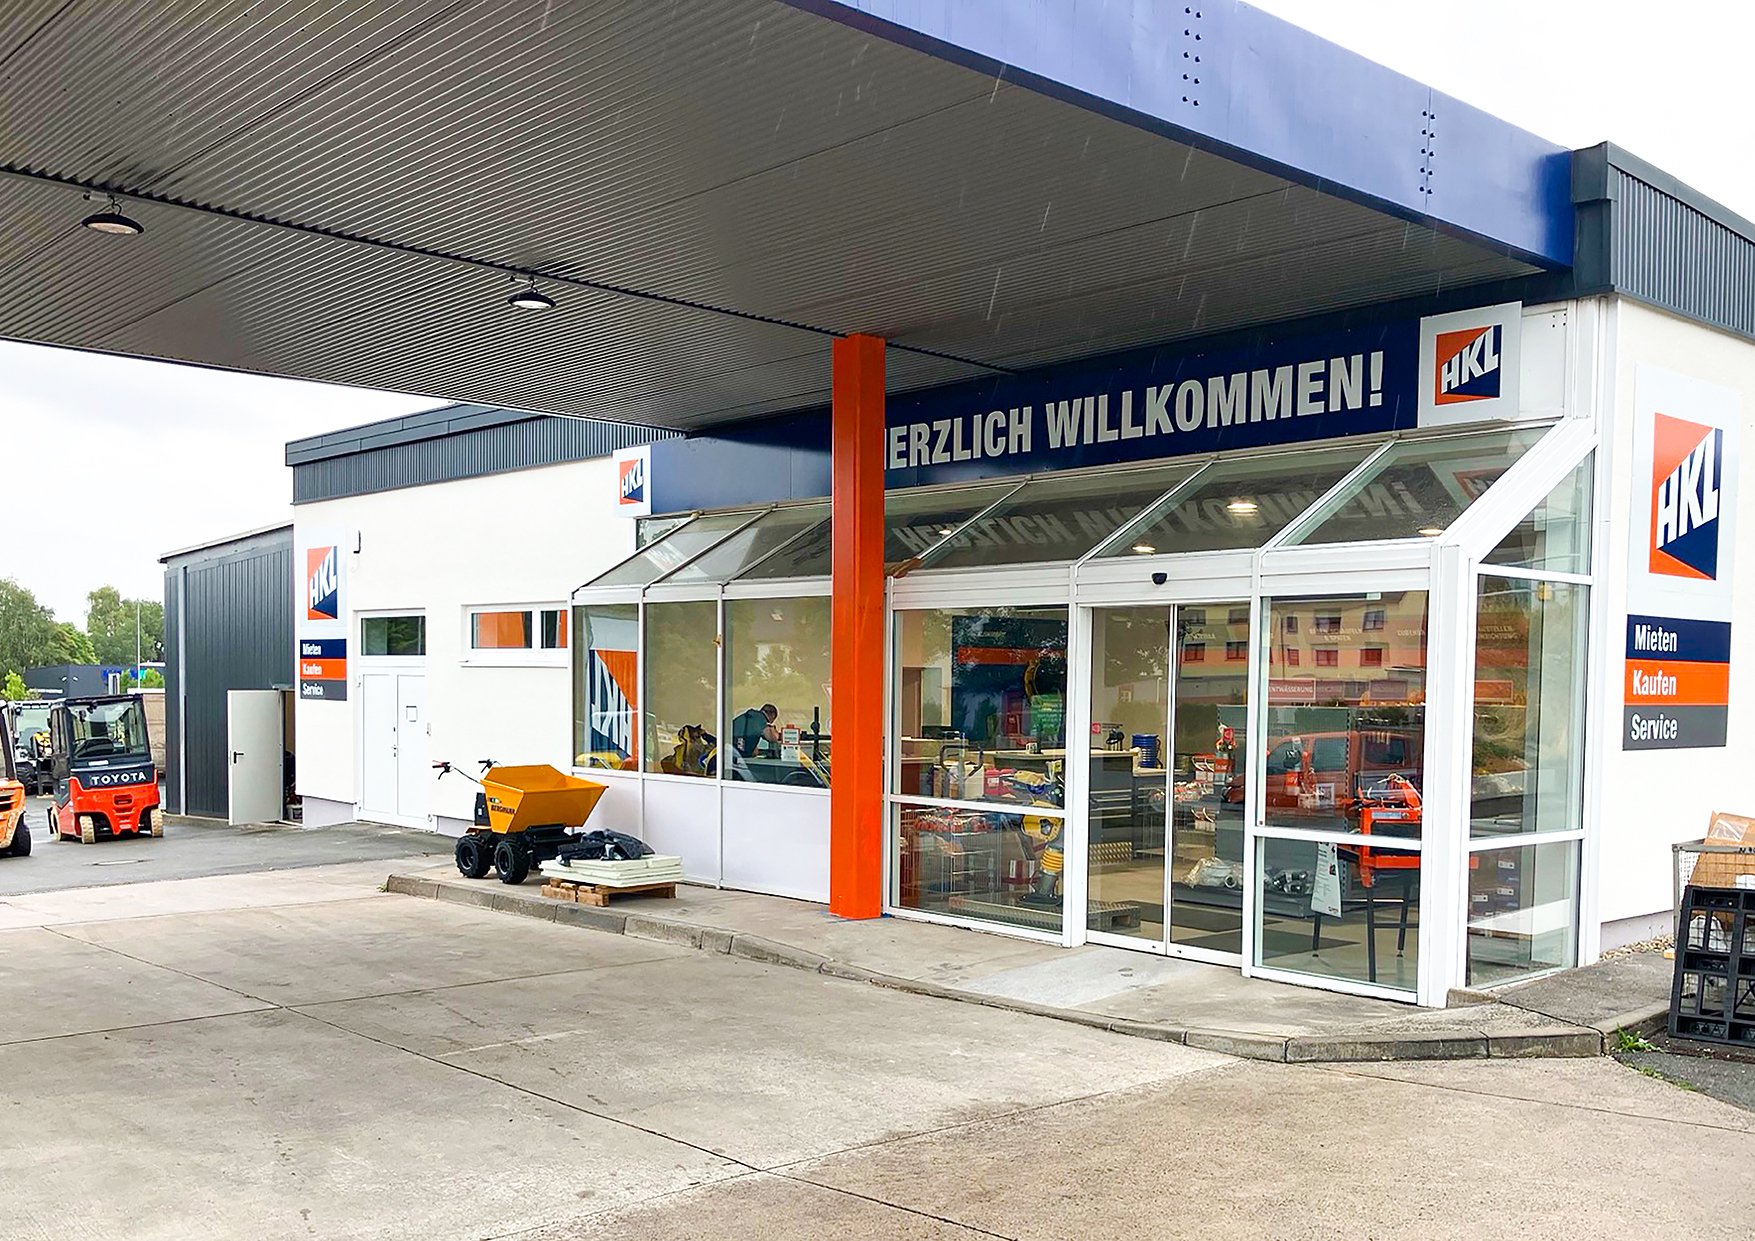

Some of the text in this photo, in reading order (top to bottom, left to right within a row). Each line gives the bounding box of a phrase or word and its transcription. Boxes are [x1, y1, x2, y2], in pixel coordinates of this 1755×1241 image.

[1440, 327, 1499, 393] HKL
[1046, 350, 1385, 449] WILLKOMMEN!
[622, 460, 644, 498] HKL
[1656, 428, 1719, 550] HKL
[309, 546, 338, 610] HKL
[302, 643, 322, 656] Mieten
[1634, 624, 1678, 652] Mieten
[302, 663, 323, 676] Kaufen
[1632, 669, 1677, 696] Kaufen
[302, 682, 324, 696] Service
[1630, 713, 1678, 740] Service
[92, 771, 146, 785] TOYOTA
